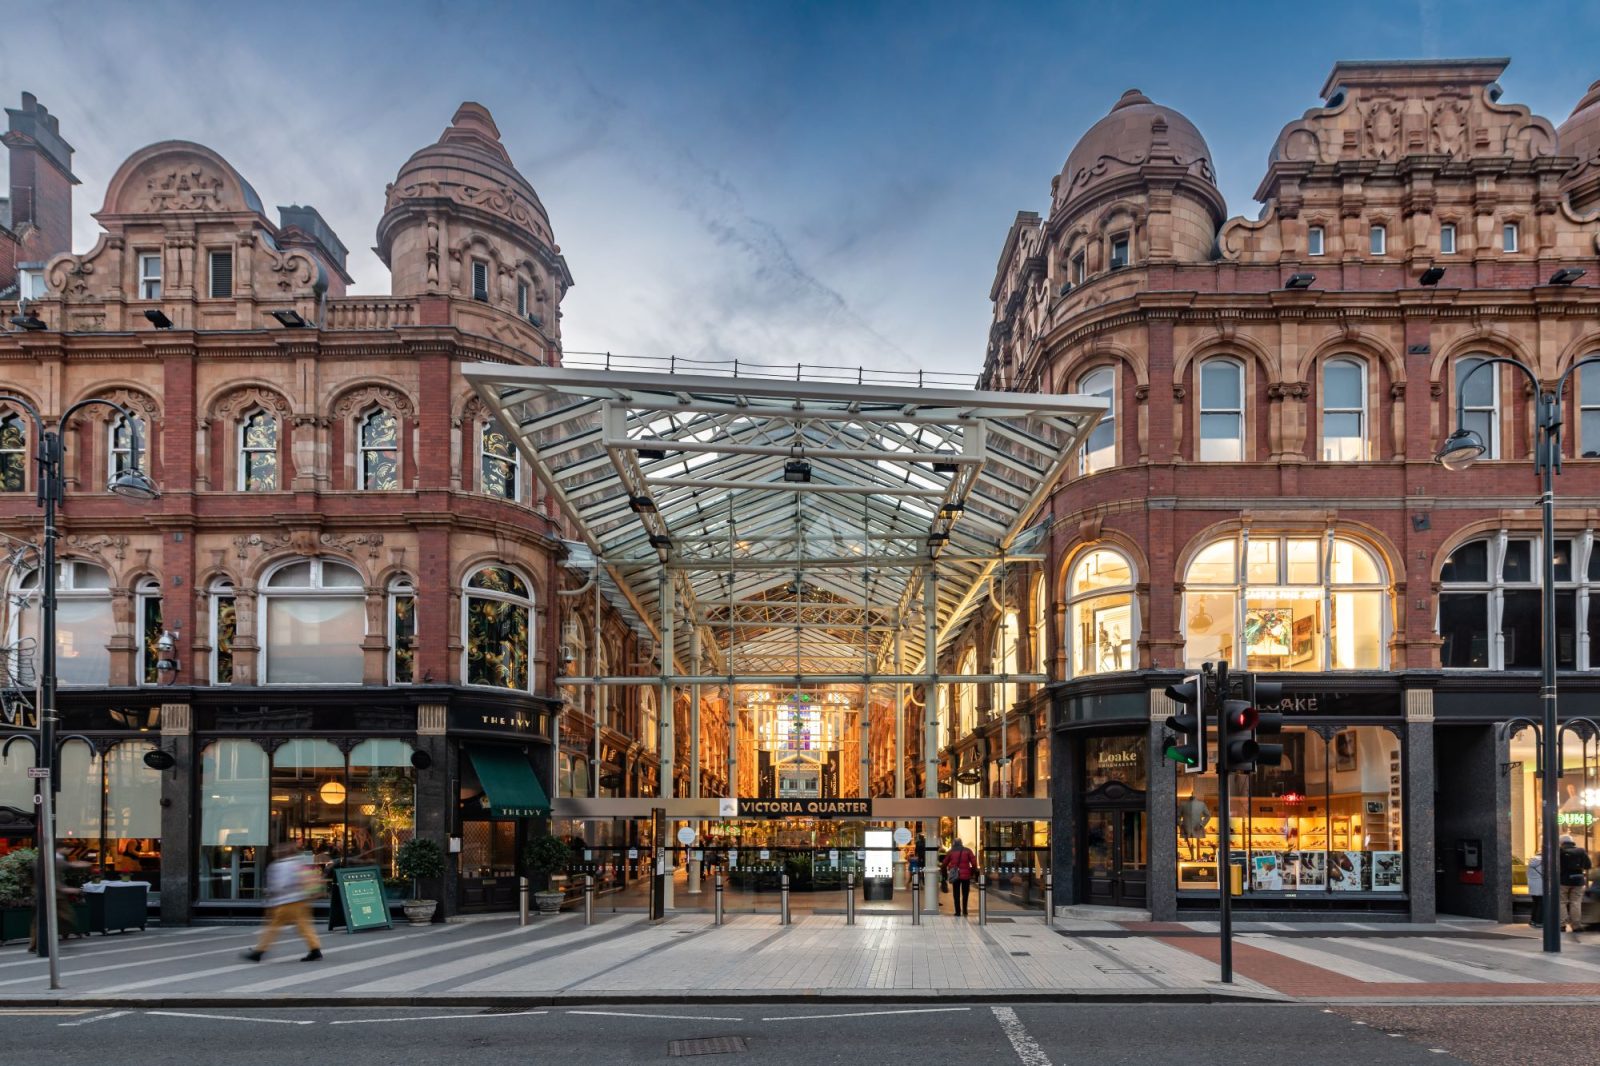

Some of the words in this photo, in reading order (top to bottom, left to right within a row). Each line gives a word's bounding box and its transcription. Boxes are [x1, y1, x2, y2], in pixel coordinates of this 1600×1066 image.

[482, 716, 505, 724] THE
[510, 718, 530, 727] IVY
[1098, 750, 1137, 763] Loake
[502, 808, 520, 816] THE
[741, 802, 803, 813] VICTORIA
[807, 802, 868, 813] QUARTER
